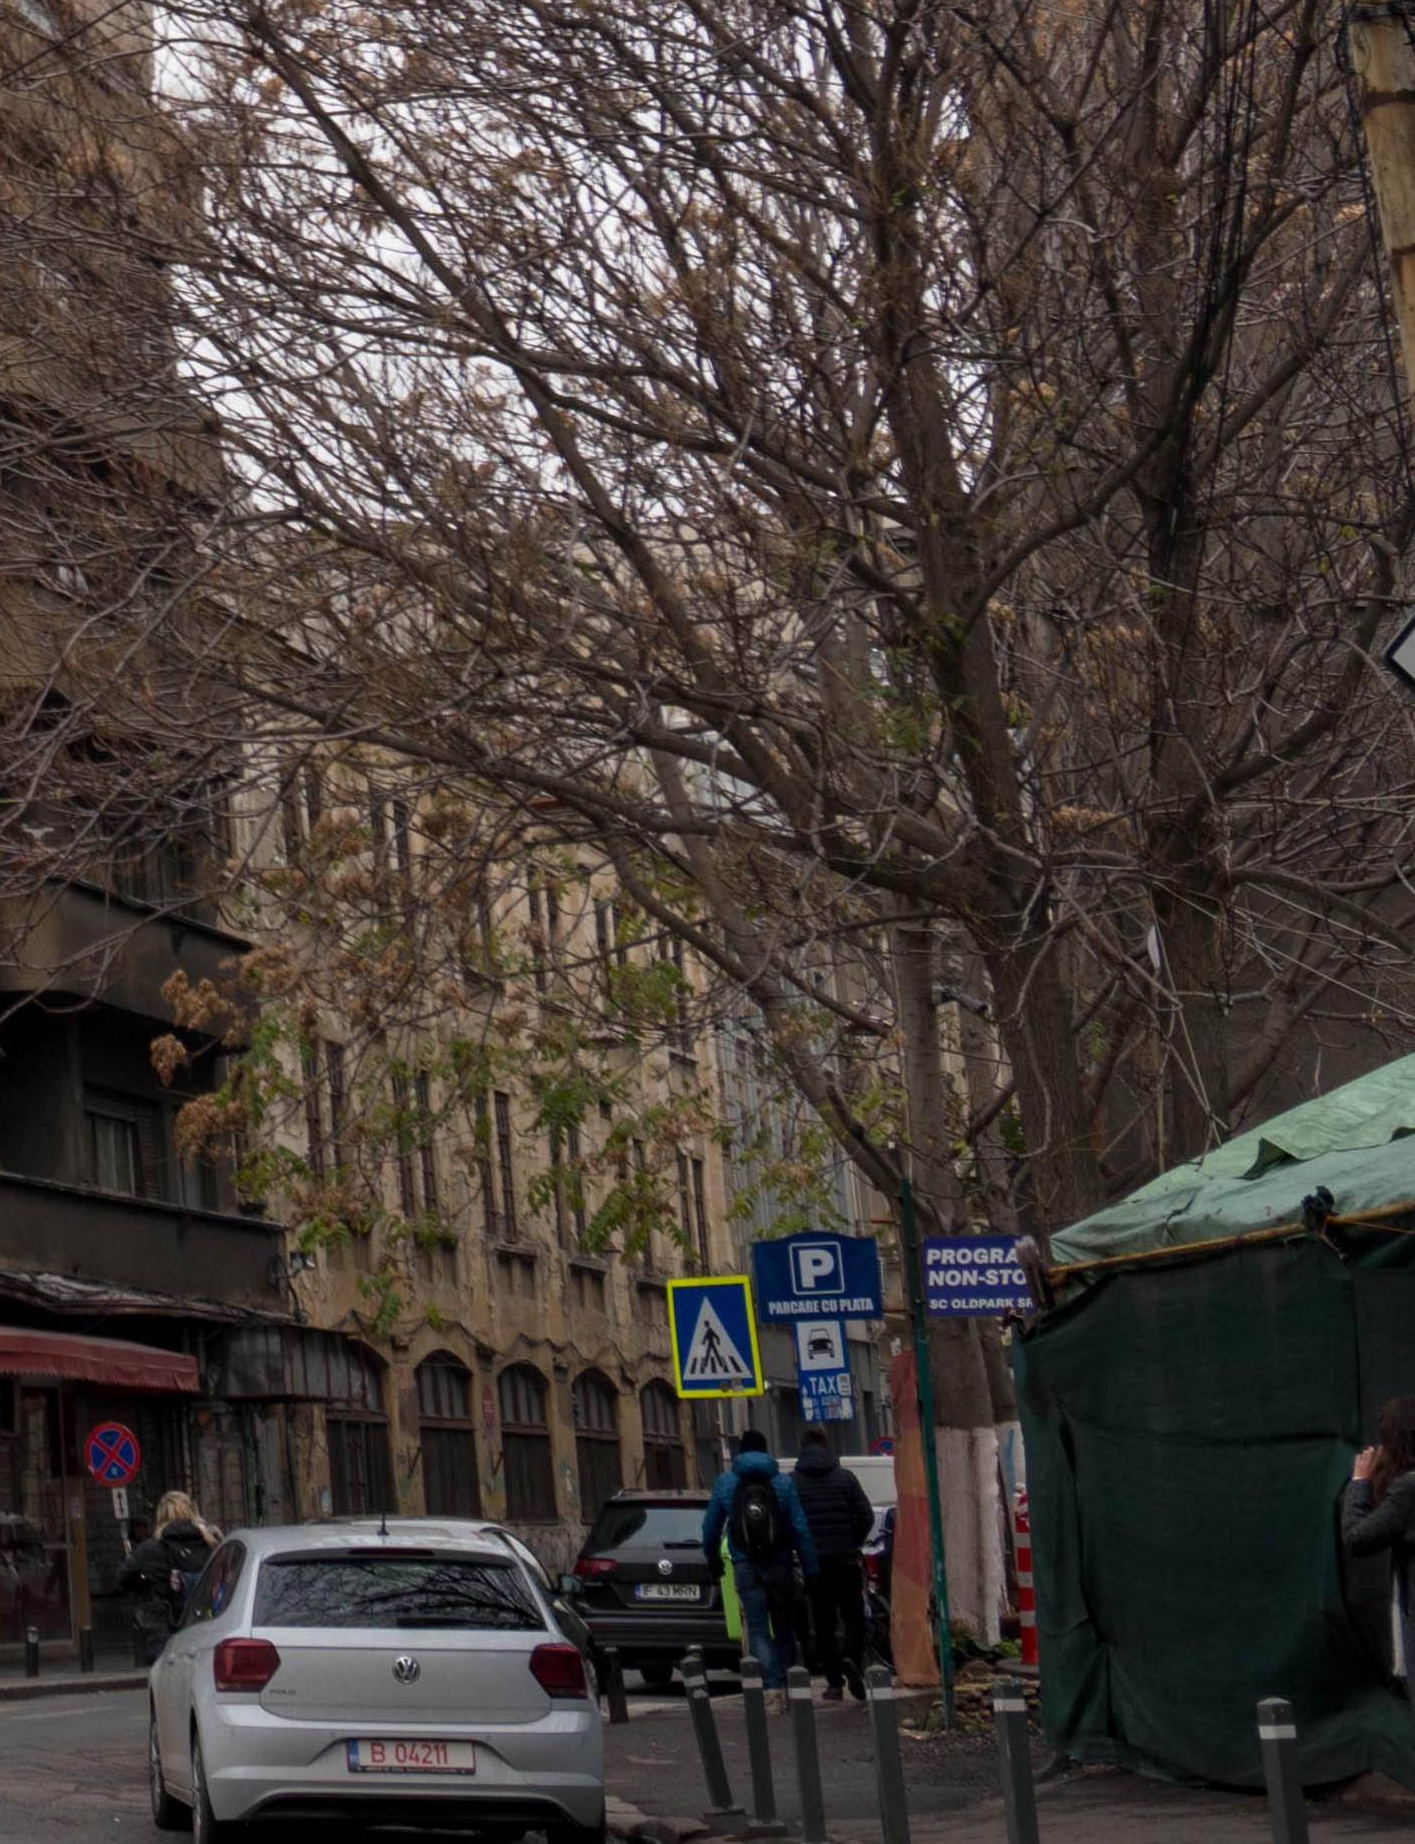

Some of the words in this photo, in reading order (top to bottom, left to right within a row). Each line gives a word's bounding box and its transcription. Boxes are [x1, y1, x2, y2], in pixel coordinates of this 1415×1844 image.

[926, 1248, 1019, 1265] PROGRA
[798, 1249, 835, 1289] P
[928, 1269, 1027, 1287] NON-STO
[768, 1298, 820, 1316] PARCARE
[821, 1299, 838, 1314] CU
[839, 1297, 875, 1313] PLATA
[930, 1299, 947, 1309] SC
[951, 1298, 1014, 1310] OLDPARK
[1017, 1298, 1033, 1309] SR
[808, 1375, 838, 1396] TAX
[371, 1742, 386, 1763] B
[395, 1743, 448, 1765] 04211
